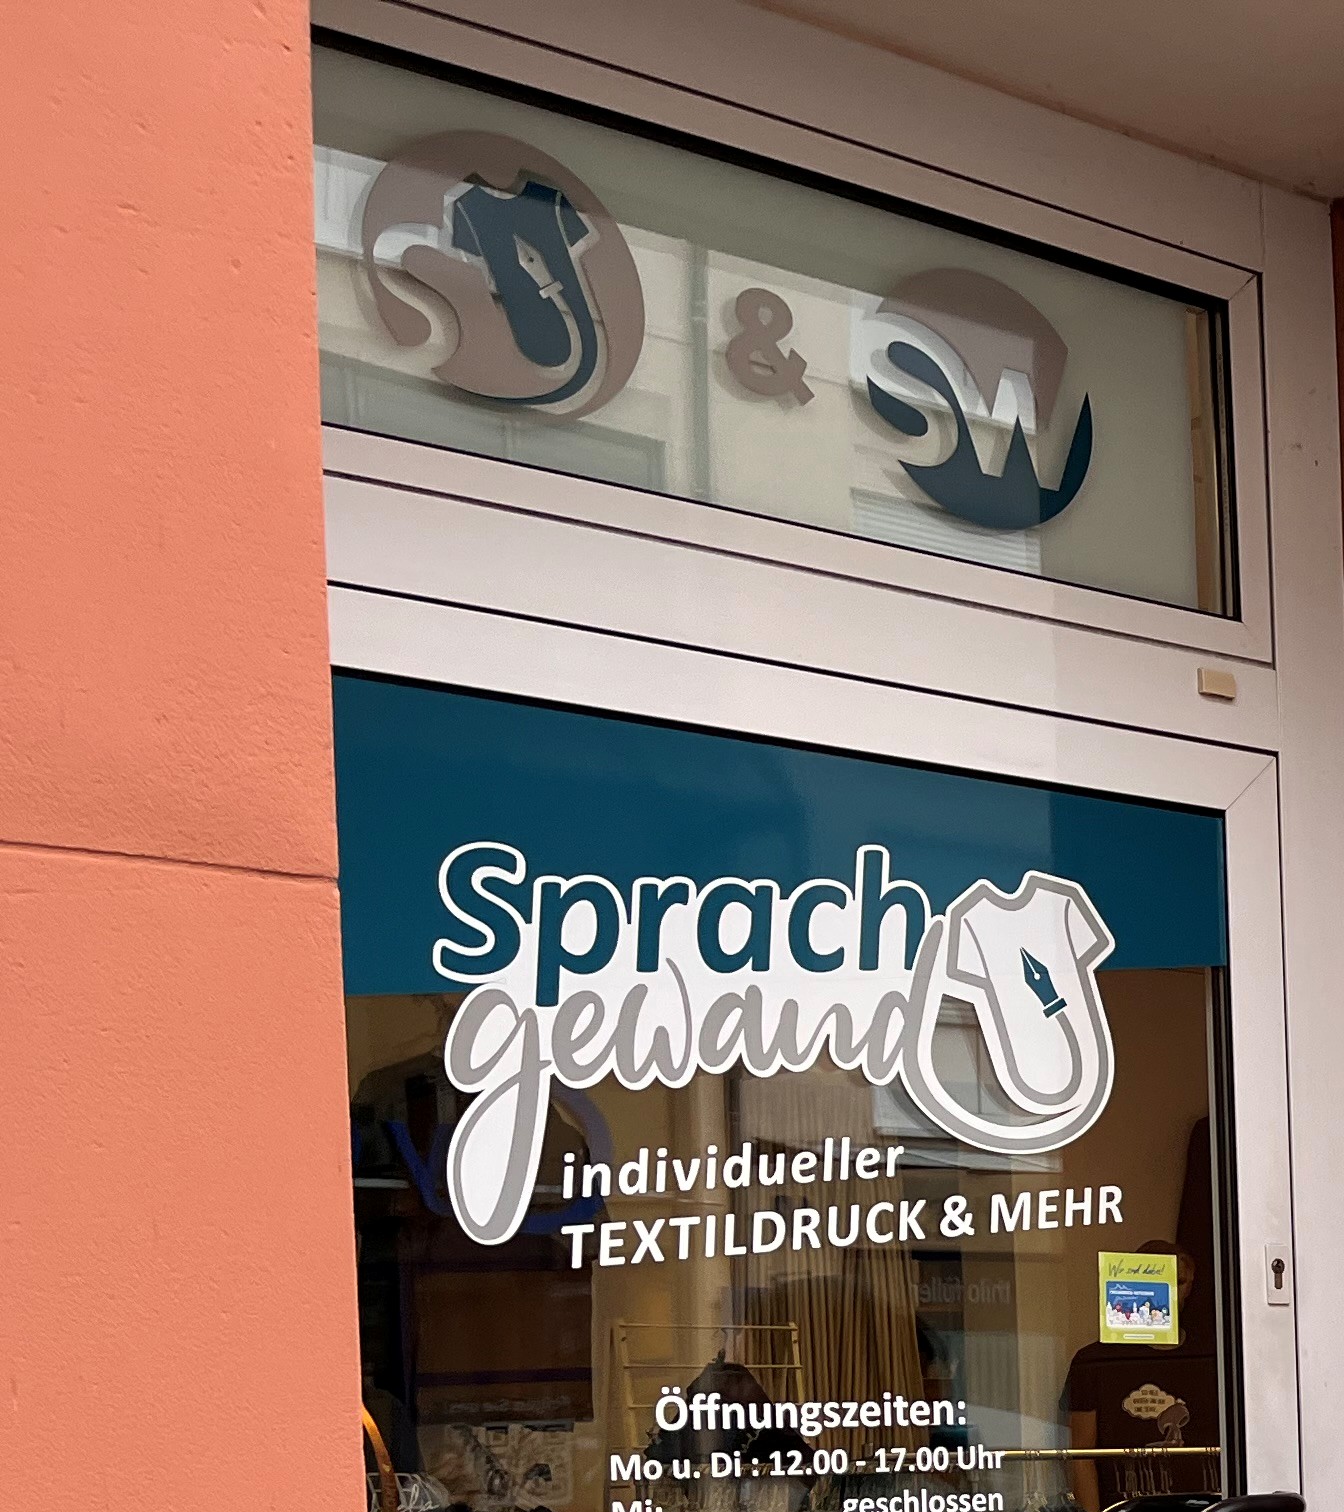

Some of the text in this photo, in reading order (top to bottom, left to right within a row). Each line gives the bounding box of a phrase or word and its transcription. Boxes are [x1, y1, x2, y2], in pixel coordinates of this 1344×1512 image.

[724, 287, 816, 407] &
[439, 846, 925, 1007] Sprach
[446, 915, 945, 1245] gewand
[562, 1137, 904, 1200] individueller
[561, 1184, 1125, 1270] TEXTILDRUCK & MEHR
[654, 1385, 968, 1438] Öffnungszeiten:
[609, 1453, 664, 1482] Mo
[674, 1457, 701, 1480] u.
[710, 1449, 742, 1478] Di
[769, 1447, 848, 1477] 12.00
[874, 1445, 951, 1474] 17.00
[956, 1443, 1006, 1471] Uhr
